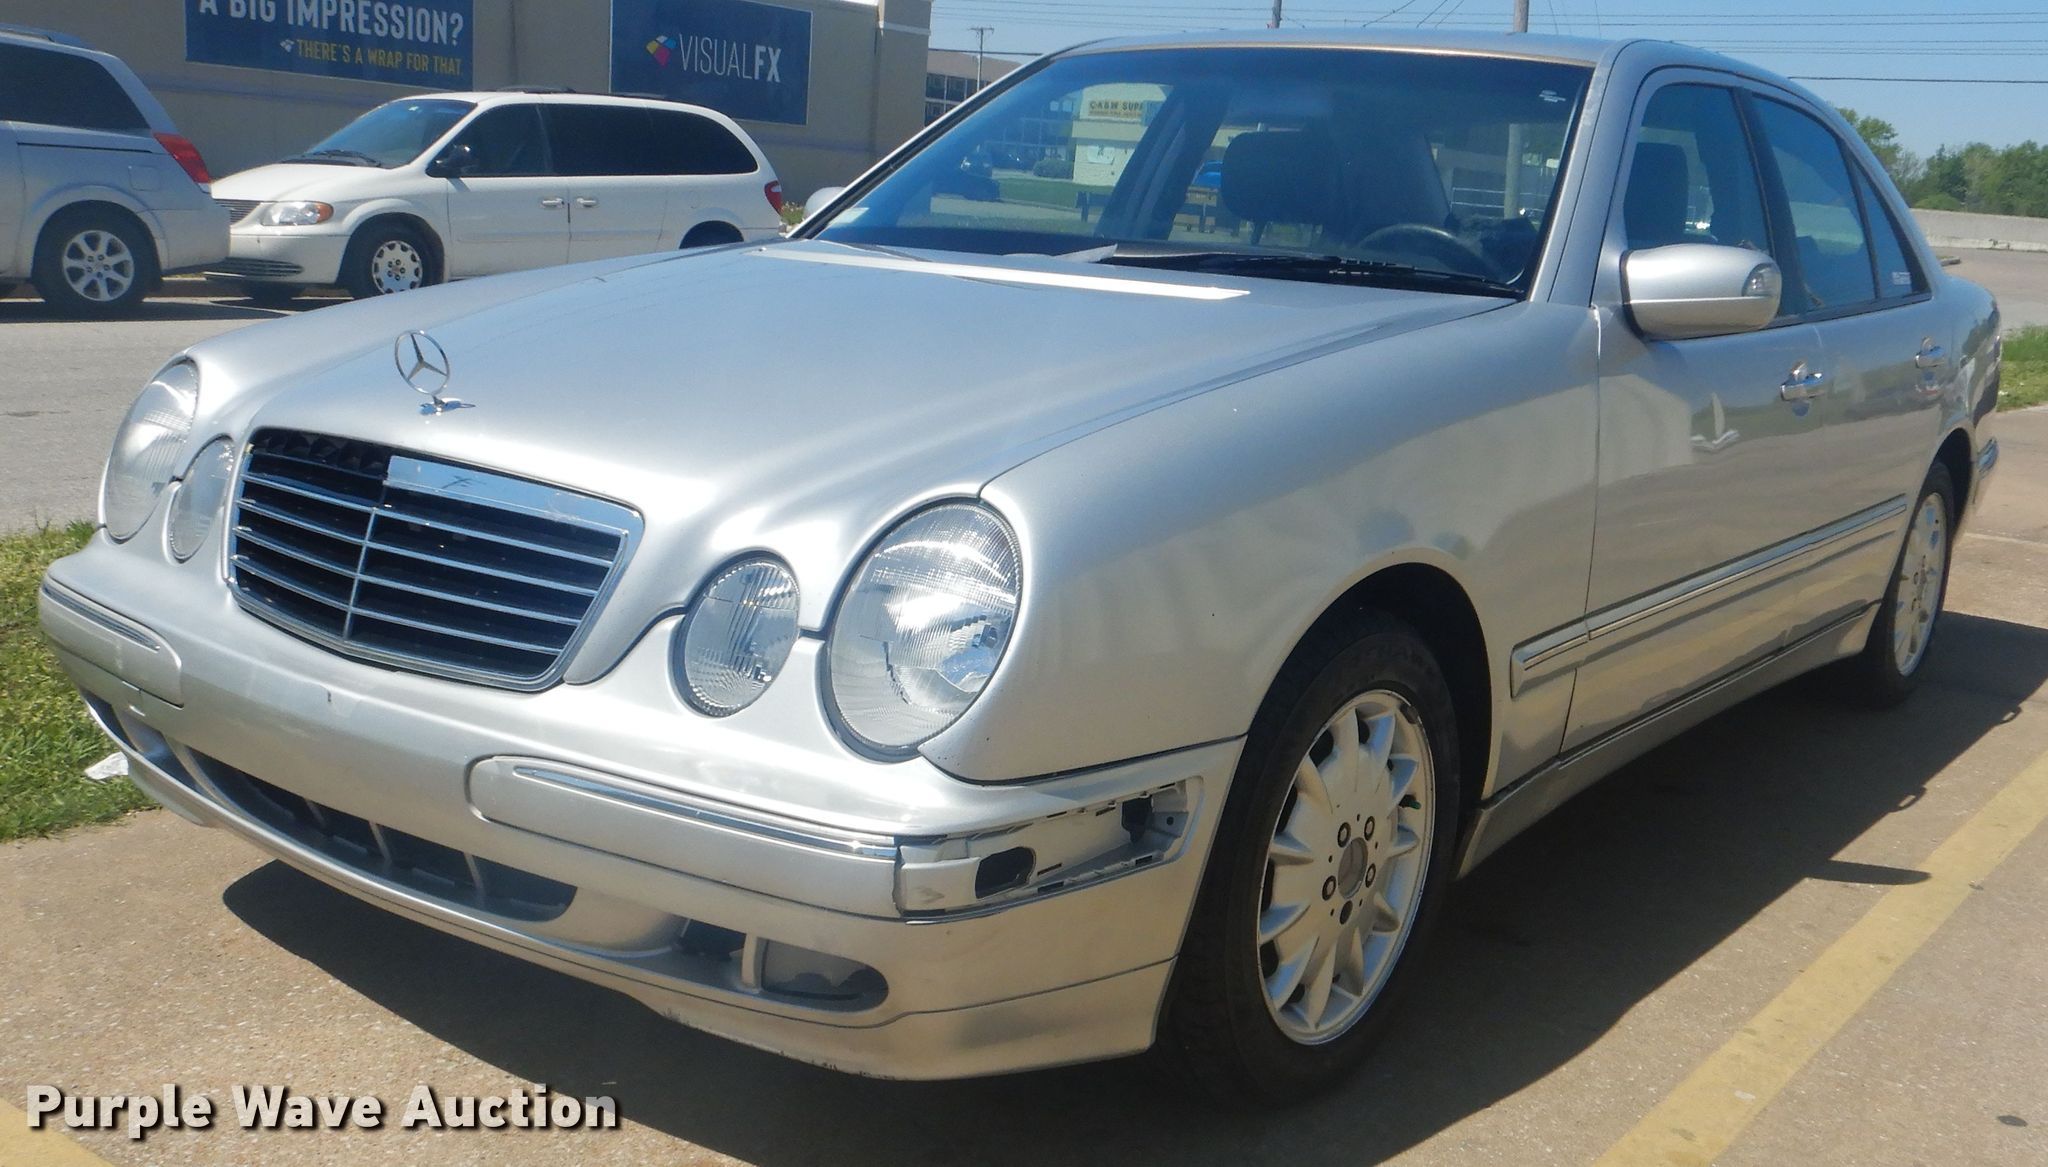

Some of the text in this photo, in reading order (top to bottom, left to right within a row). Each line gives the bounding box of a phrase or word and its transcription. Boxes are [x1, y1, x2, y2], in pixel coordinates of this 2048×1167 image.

[230, 0, 276, 23] BIG
[287, 0, 464, 46] IMPRESSION?
[297, 39, 351, 63] THERE'S
[354, 47, 363, 65] A
[367, 49, 403, 69] WRAP
[406, 52, 429, 72] FOR
